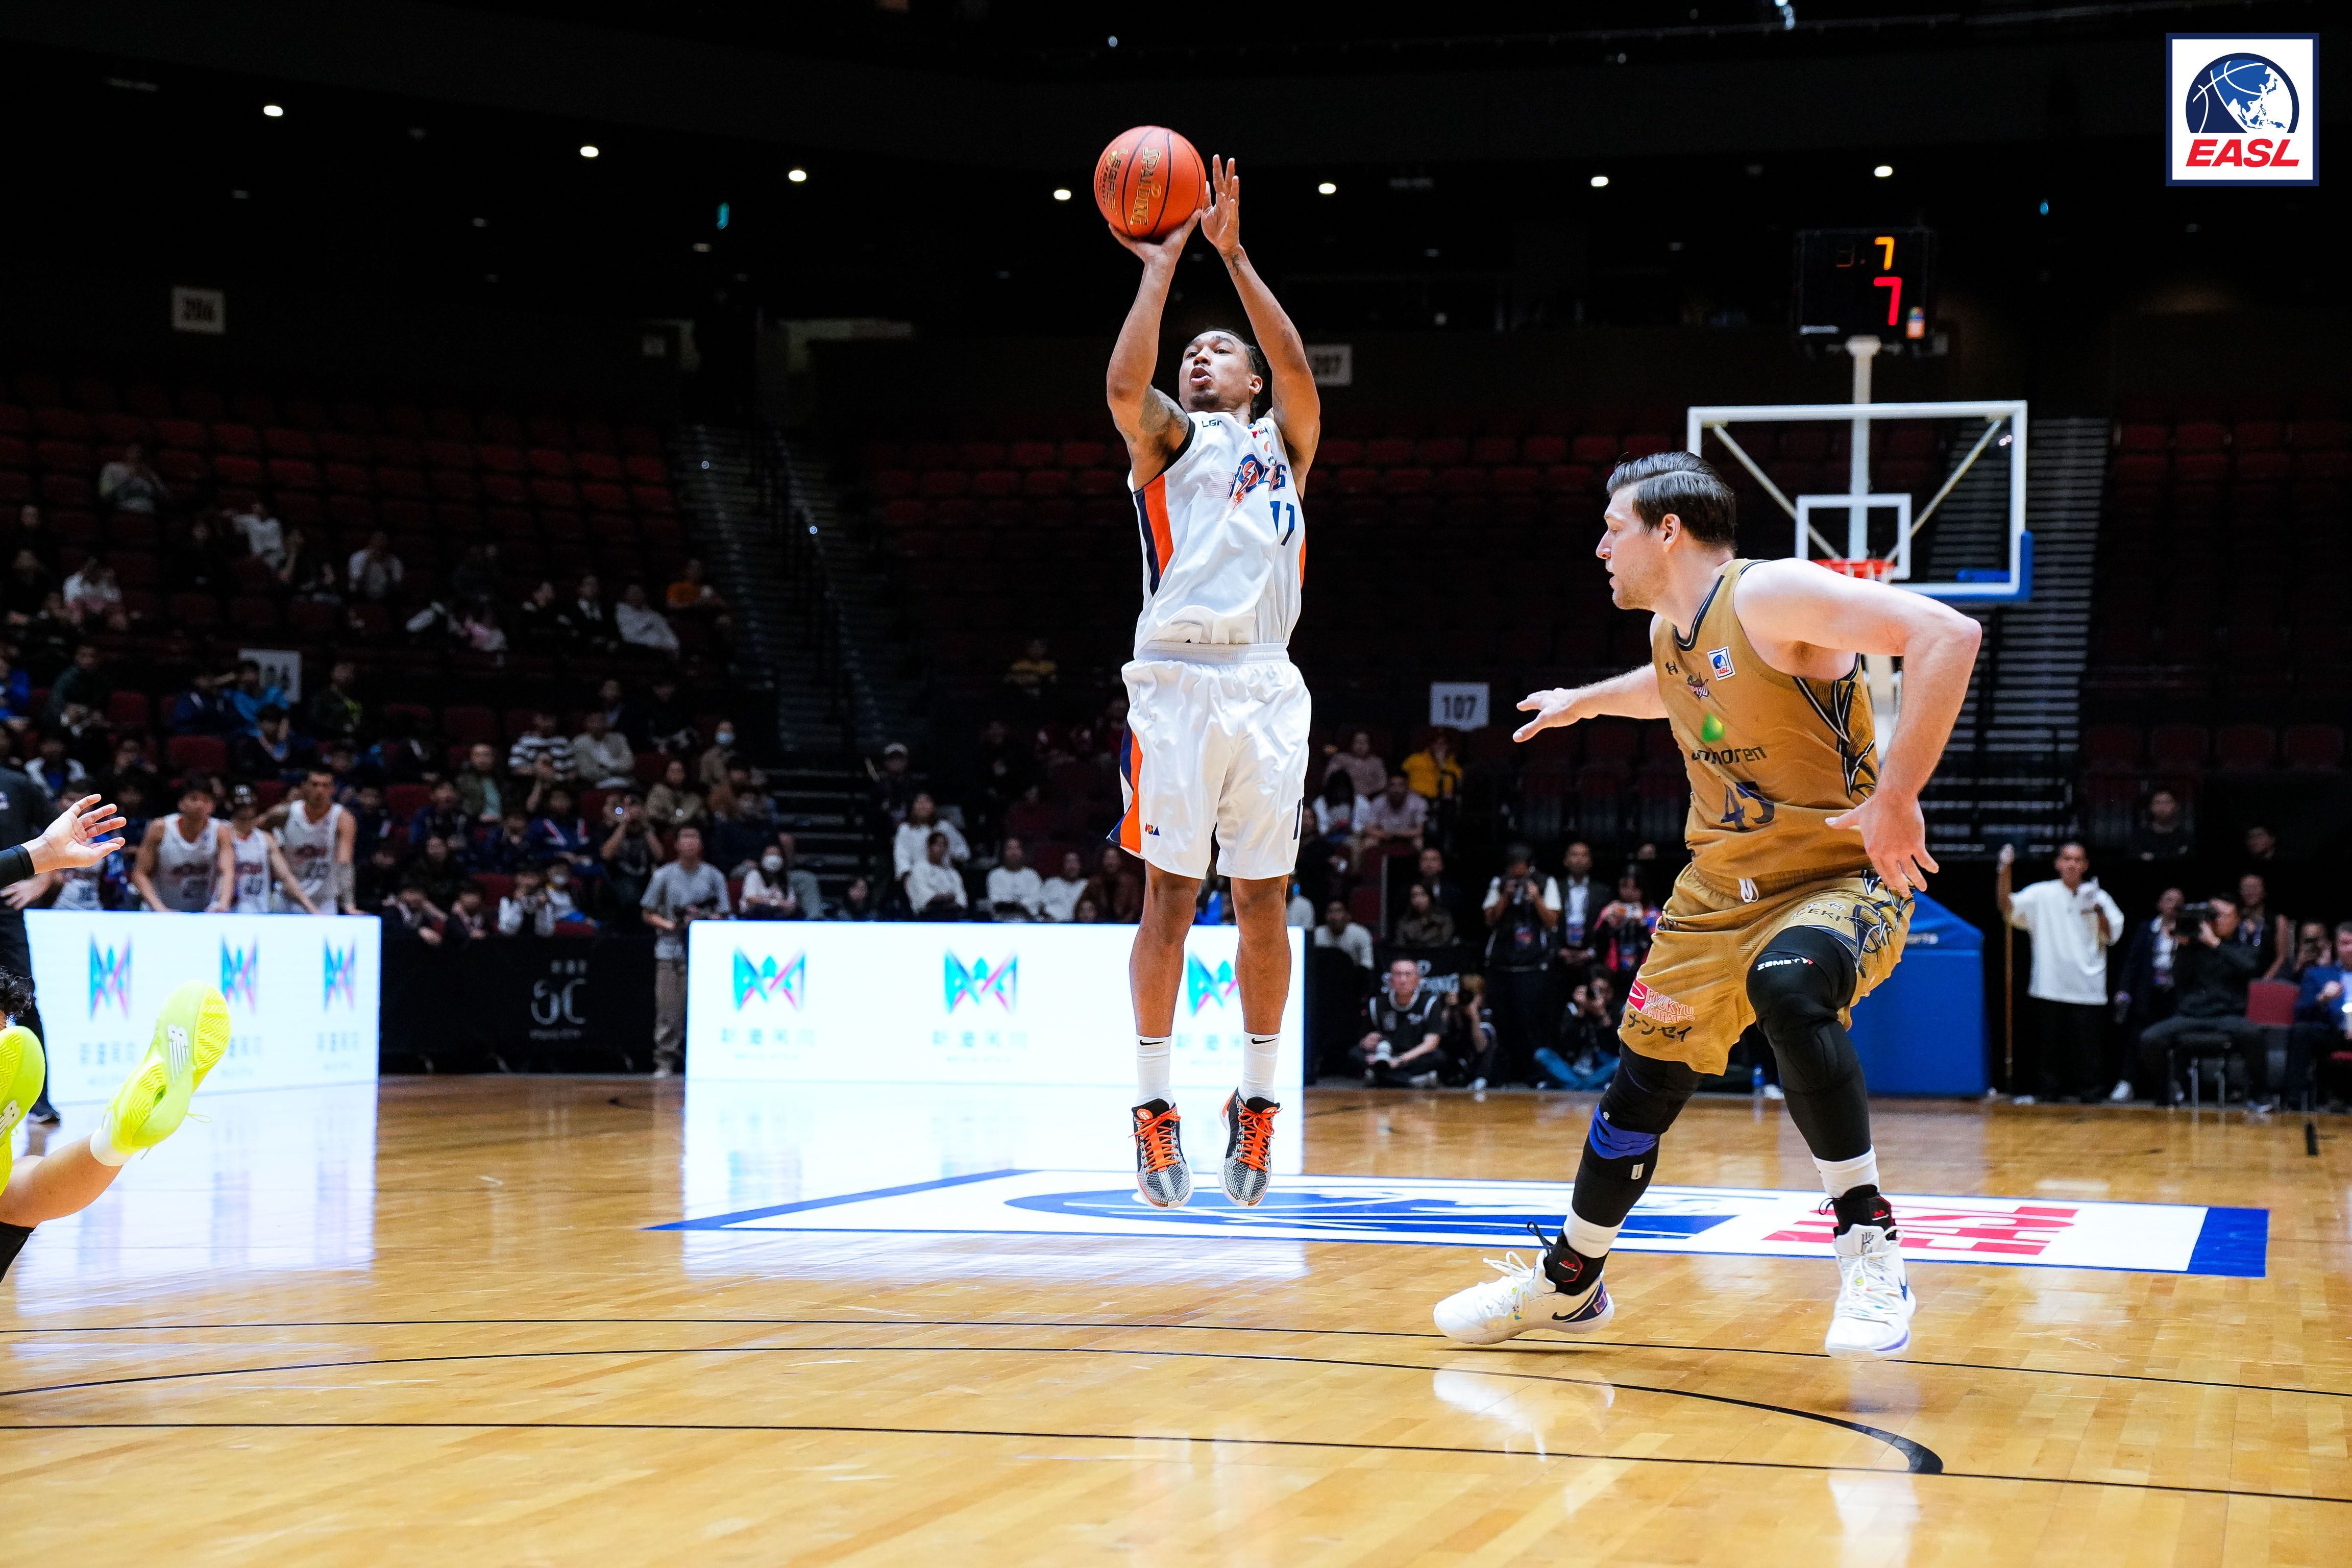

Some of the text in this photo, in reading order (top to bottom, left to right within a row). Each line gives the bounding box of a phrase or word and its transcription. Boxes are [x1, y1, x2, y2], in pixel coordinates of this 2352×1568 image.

[1874, 236, 1895, 270] 7
[1874, 277, 1902, 326] 7
[1442, 694, 1478, 720] 107
[1721, 780, 1775, 831] 45
[1648, 988, 1694, 1016] RYUKYU
